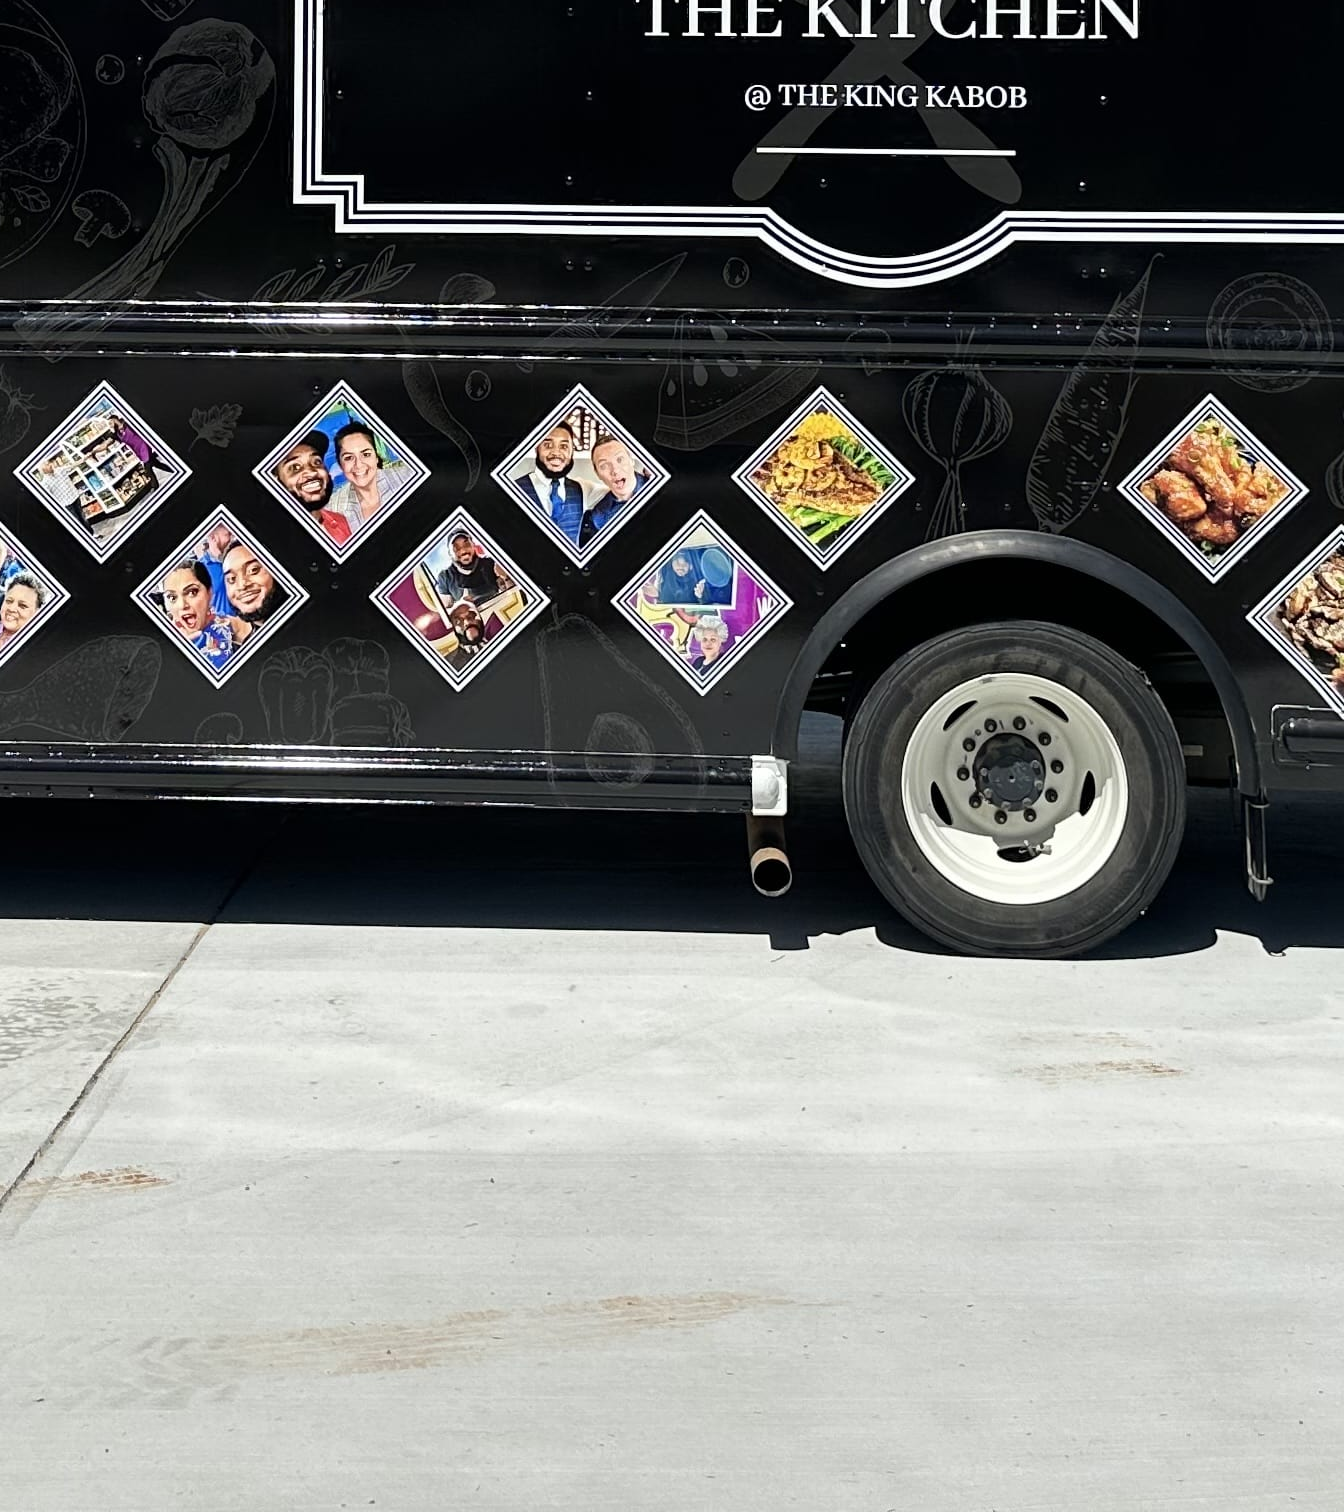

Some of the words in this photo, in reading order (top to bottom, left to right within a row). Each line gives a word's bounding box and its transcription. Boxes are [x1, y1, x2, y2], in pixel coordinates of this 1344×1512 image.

[743, 83, 773, 112] @
[777, 83, 839, 108] THE
[842, 84, 920, 109] KING
[924, 85, 1028, 110] KABOB
